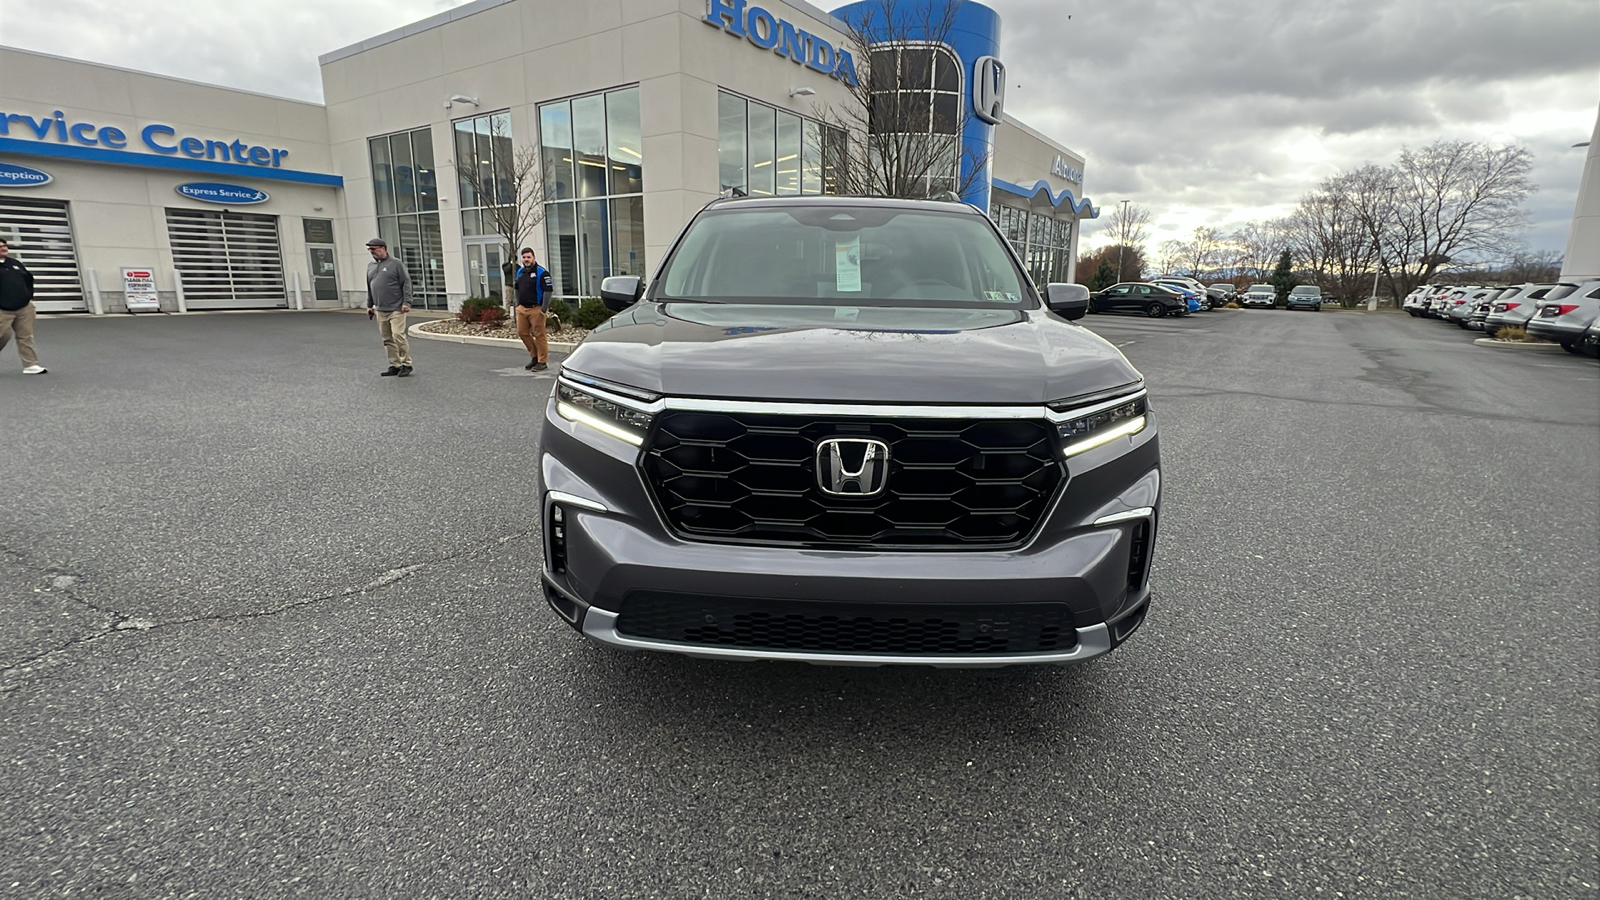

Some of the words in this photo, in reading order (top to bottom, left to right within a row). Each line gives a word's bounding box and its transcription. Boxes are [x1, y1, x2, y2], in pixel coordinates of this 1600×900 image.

[703, 0, 860, 87] HONDA
[0, 110, 127, 149] rvice
[141, 124, 289, 167] Center
[182, 186, 218, 196] Express
[219, 189, 252, 199] Service
